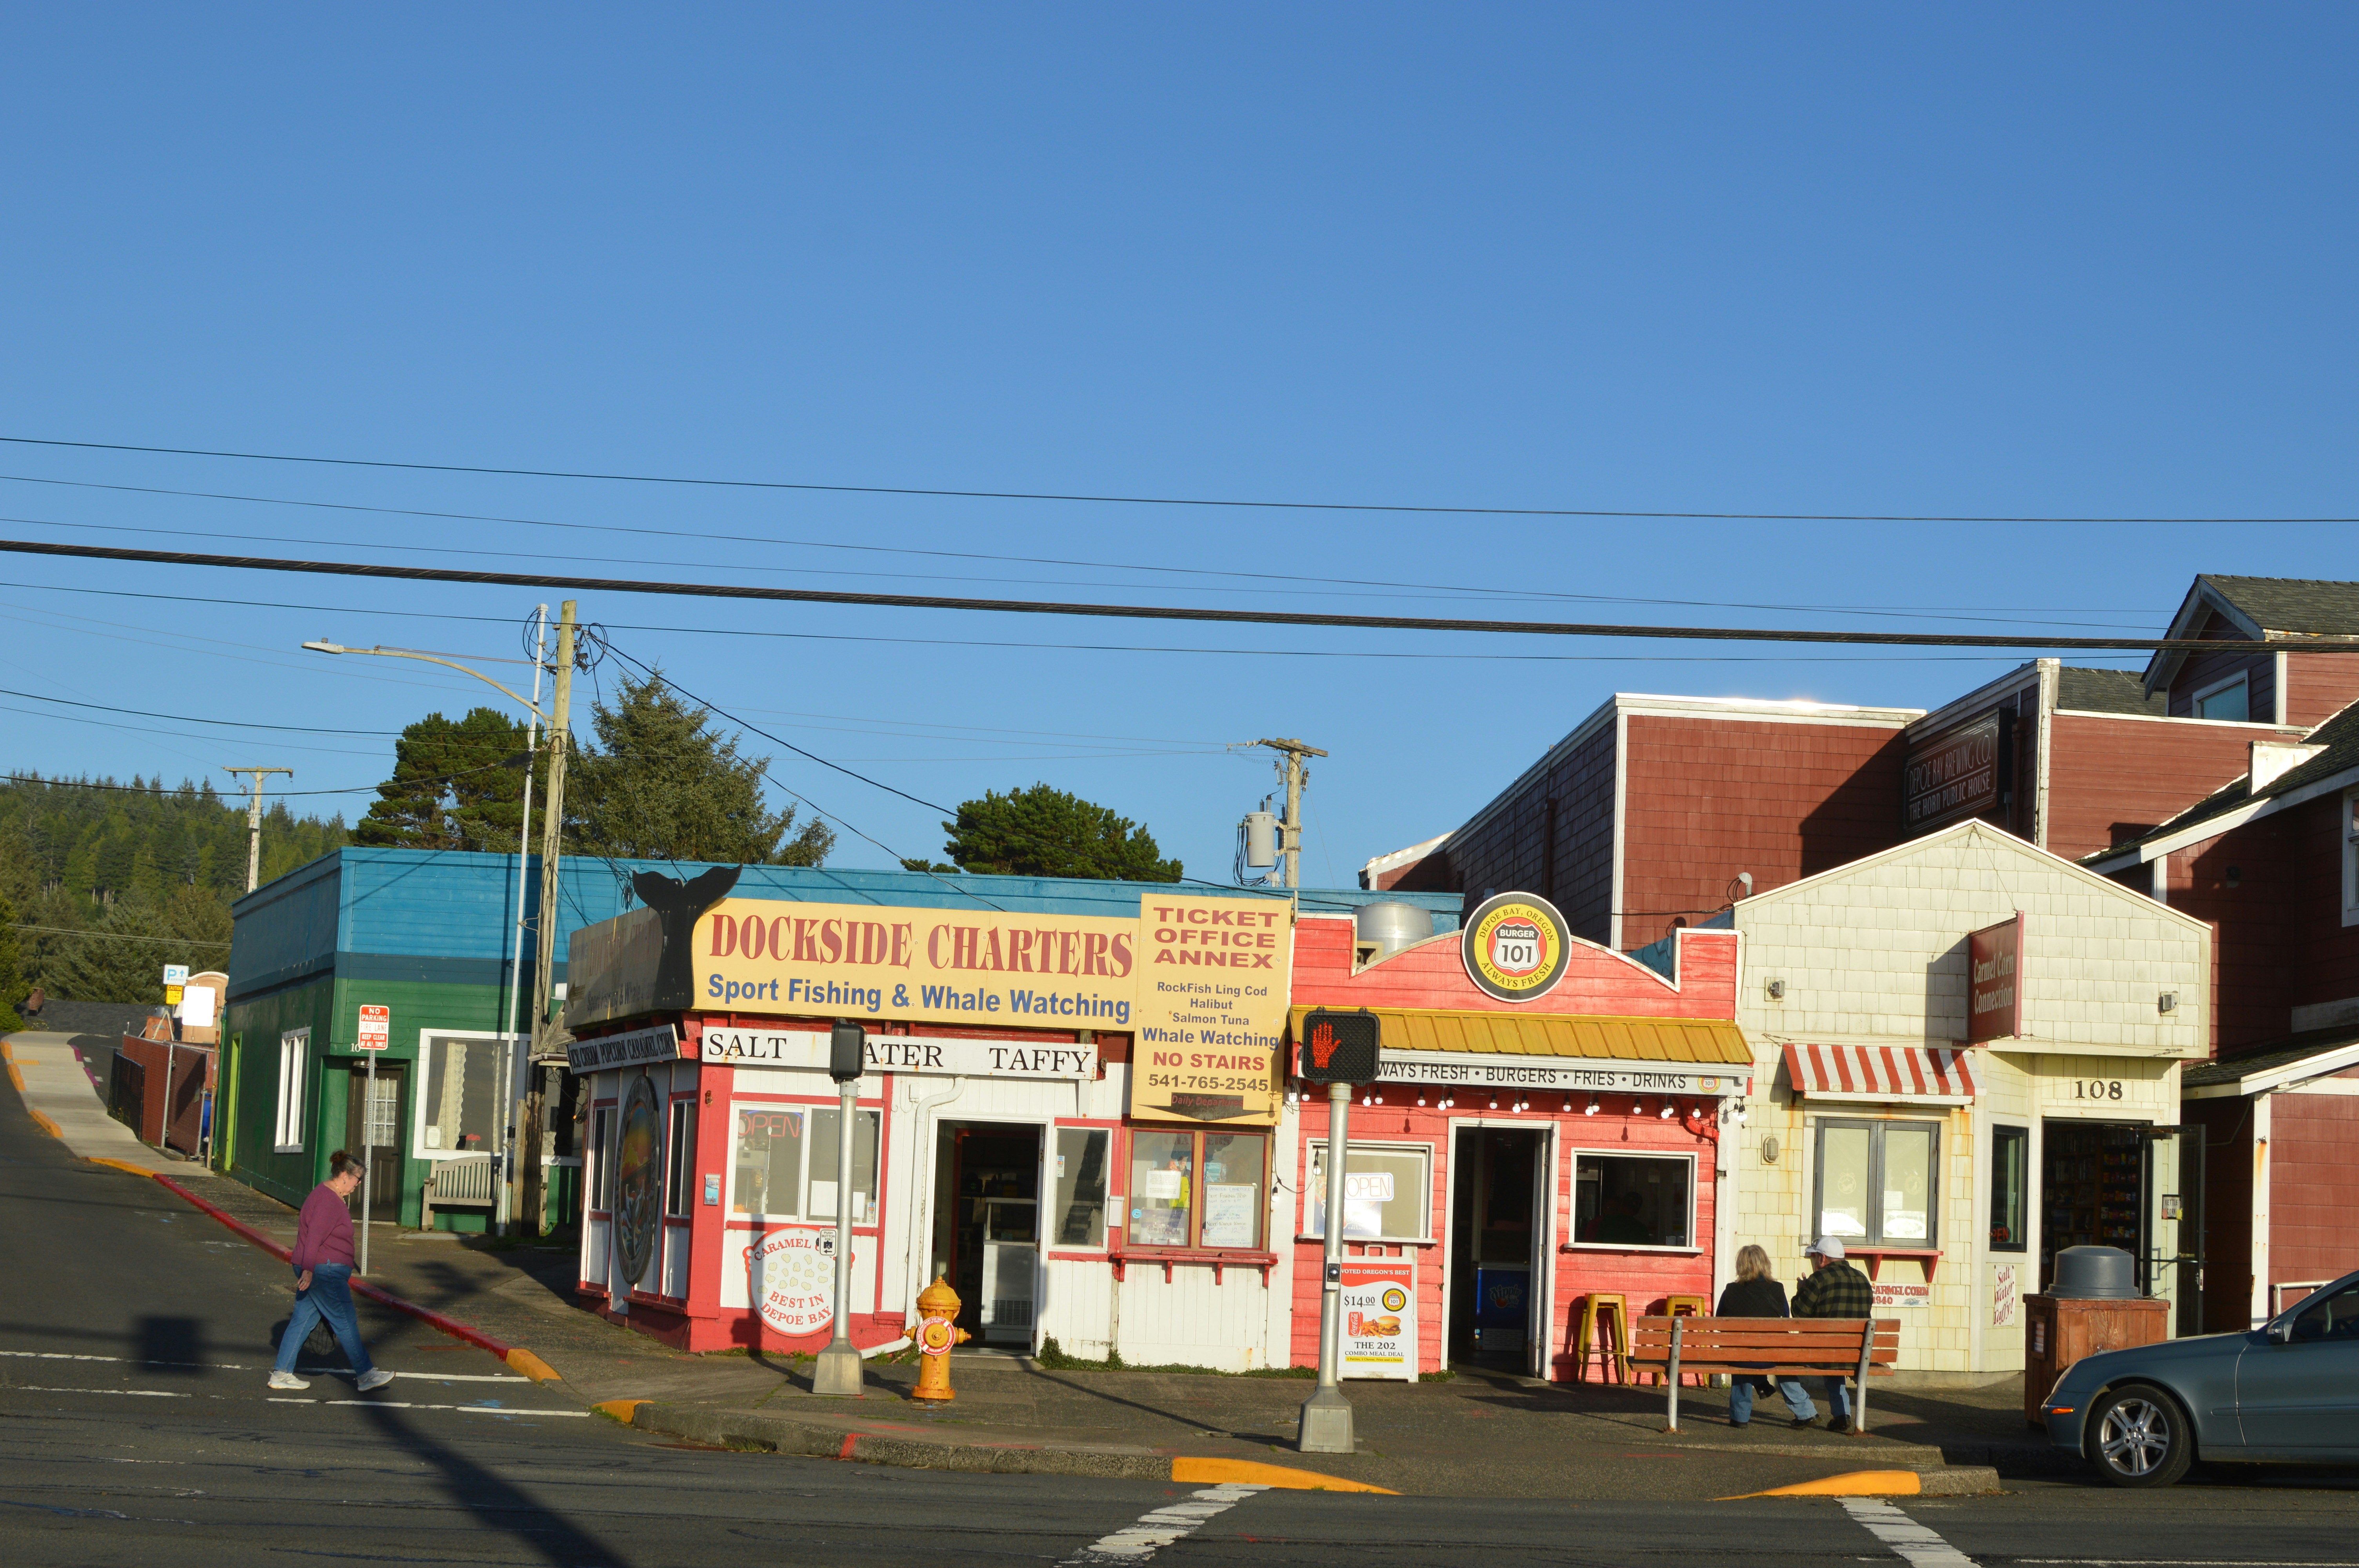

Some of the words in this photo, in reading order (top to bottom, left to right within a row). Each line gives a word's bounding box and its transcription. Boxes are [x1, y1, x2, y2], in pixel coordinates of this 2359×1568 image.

[1909, 762, 1931, 795] DEPOE
[1933, 755, 1944, 785] BAY
[1945, 742, 1974, 780] BREWING
[1977, 735, 1991, 765] CO.
[1909, 801, 1921, 822] THE
[1943, 782, 1966, 808] PUBLIC
[1968, 771, 1990, 798] HOUSE
[1153, 907, 1279, 927] TICKET
[1479, 913, 1501, 938] DEPOE
[1503, 908, 1523, 916] BAY,
[1527, 910, 1554, 941] OREGON
[1154, 928, 1275, 948] OFFICE
[1500, 929, 1534, 938] BURGER
[709, 914, 912, 970] DOCKSIDE
[928, 923, 1132, 980] CHARTERS
[1502, 945, 1532, 963] 101
[1154, 949, 1273, 969] ANNEX
[1974, 953, 1996, 984] Carmel
[1997, 951, 2013, 977] Corn
[1481, 962, 1518, 987] ALWAYS
[1521, 962, 1551, 987] FRESH
[708, 974, 779, 1004] Sport
[789, 978, 881, 1013] Fishing
[892, 984, 911, 1008] &
[921, 985, 1001, 1012] Whale
[1010, 989, 1130, 1025] Watching
[1157, 982, 1211, 993] RockFish
[1216, 984, 1240, 997] Ling
[1245, 985, 1267, 996] Cod
[1975, 982, 2012, 1014] Connection
[1190, 998, 1233, 1010] Halibut
[1172, 1013, 1216, 1024] Salmon
[1221, 1015, 1249, 1025] Tuna
[1142, 1027, 1194, 1043] Whale
[1200, 1030, 1279, 1051] Watching
[570, 1049, 581, 1069] ICE
[580, 1045, 600, 1066] CREAM
[599, 1040, 628, 1063] POPCORN
[627, 1036, 658, 1060] CARAMEL
[657, 1031, 676, 1055] CORN
[708, 1034, 787, 1058] SALT
[864, 1042, 944, 1067] ATER
[989, 1047, 1091, 1073] TAFFY
[1153, 1052, 1183, 1067] NO
[1190, 1054, 1265, 1071] STAIRS
[1149, 1074, 1269, 1091] 541-765-2545
[1379, 1062, 1416, 1078] WAYS
[1421, 1064, 1468, 1080] FRESH
[1486, 1066, 1556, 1083] BURGERS
[1574, 1070, 1615, 1086] FRIES
[1633, 1073, 1686, 1089] DRINKS
[2075, 1080, 2123, 1100] 108
[1172, 1095, 1194, 1107] Daily
[1196, 1096, 1243, 1107] Departures
[738, 1114, 800, 1138] OPEN
[1347, 1177, 1390, 1196] OPEN
[1993, 1227, 2009, 1242] PEN
[754, 1239, 811, 1261] CARAMEL
[1997, 1266, 2010, 1286] Salt
[769, 1291, 804, 1308] BEST
[809, 1293, 824, 1307] IN
[1871, 1285, 1904, 1295] CARMEL
[1905, 1286, 1929, 1296] CORN
[1873, 1296, 1893, 1305] 1940
[1995, 1281, 2014, 1305] Water
[1344, 1295, 1375, 1307] $14.00
[1993, 1297, 2014, 1325] Taffy!
[761, 1303, 803, 1325] DEPOE
[808, 1306, 832, 1324] BAY
